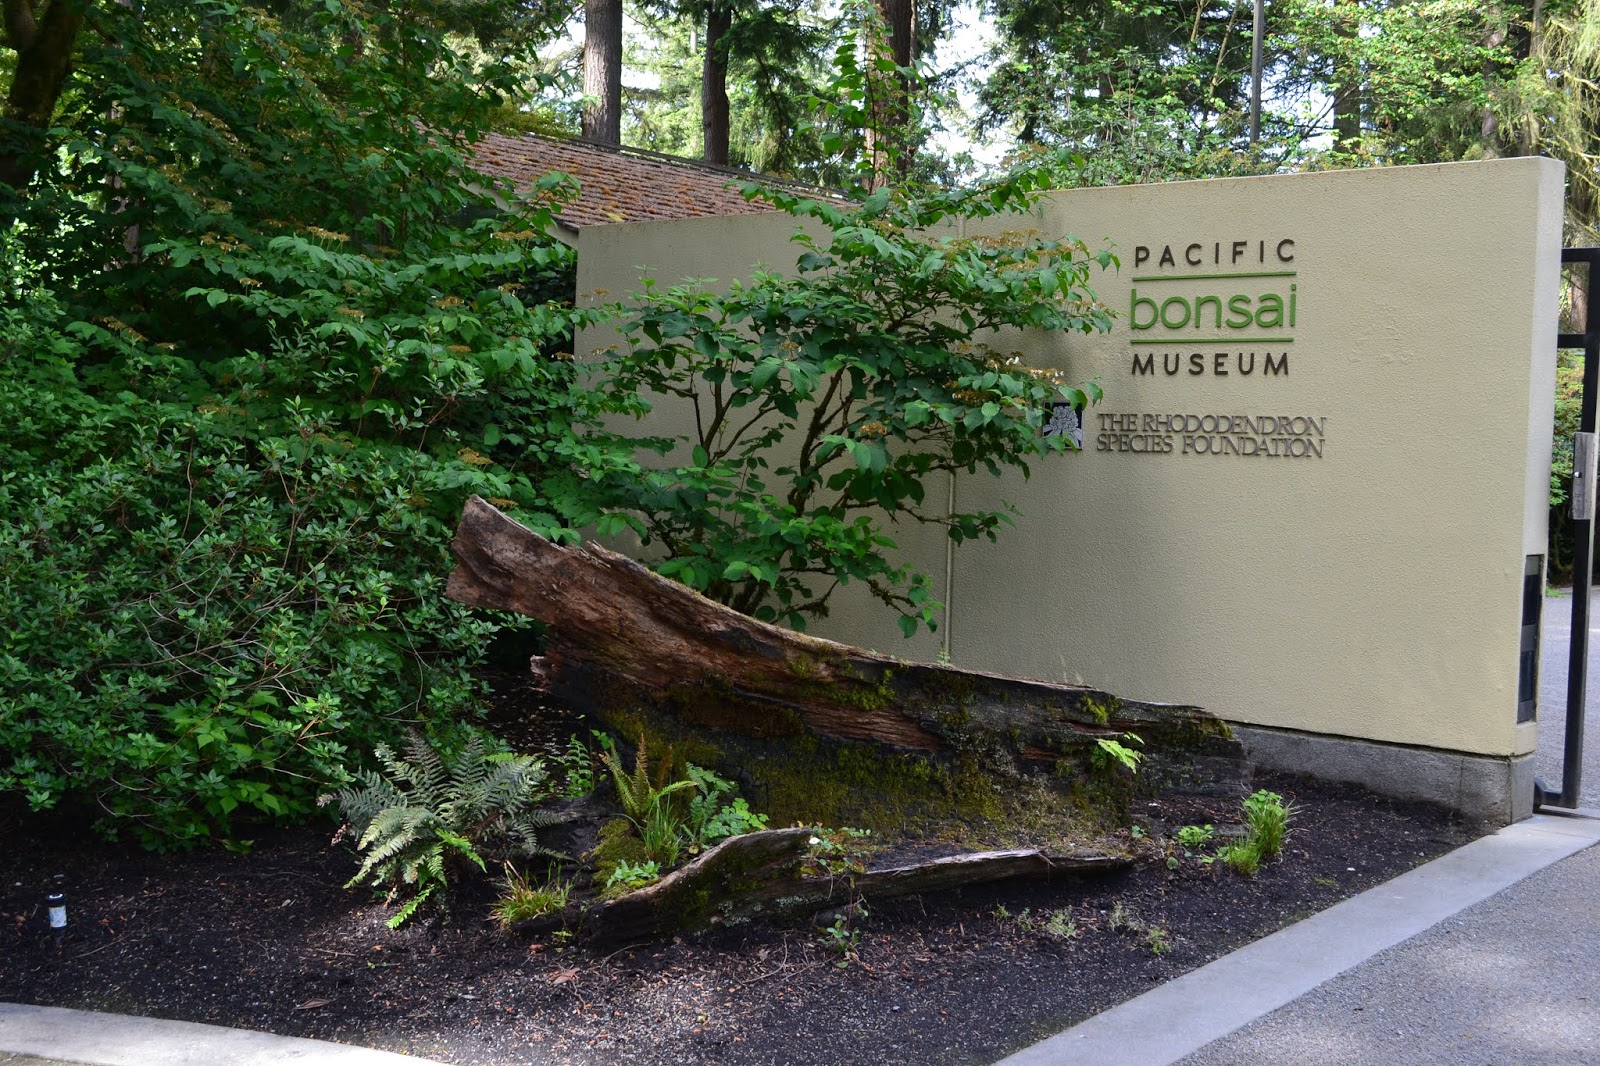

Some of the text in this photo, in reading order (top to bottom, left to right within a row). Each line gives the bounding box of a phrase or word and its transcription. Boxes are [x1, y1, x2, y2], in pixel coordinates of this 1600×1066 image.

[1135, 238, 1295, 267] PACIFIC
[1130, 283, 1297, 330] bonsai
[1131, 352, 1289, 375] MUSEUM
[1098, 413, 1327, 436] THE RHODODENDRON
[1096, 434, 1325, 458] SPECIES FOUNDATION
